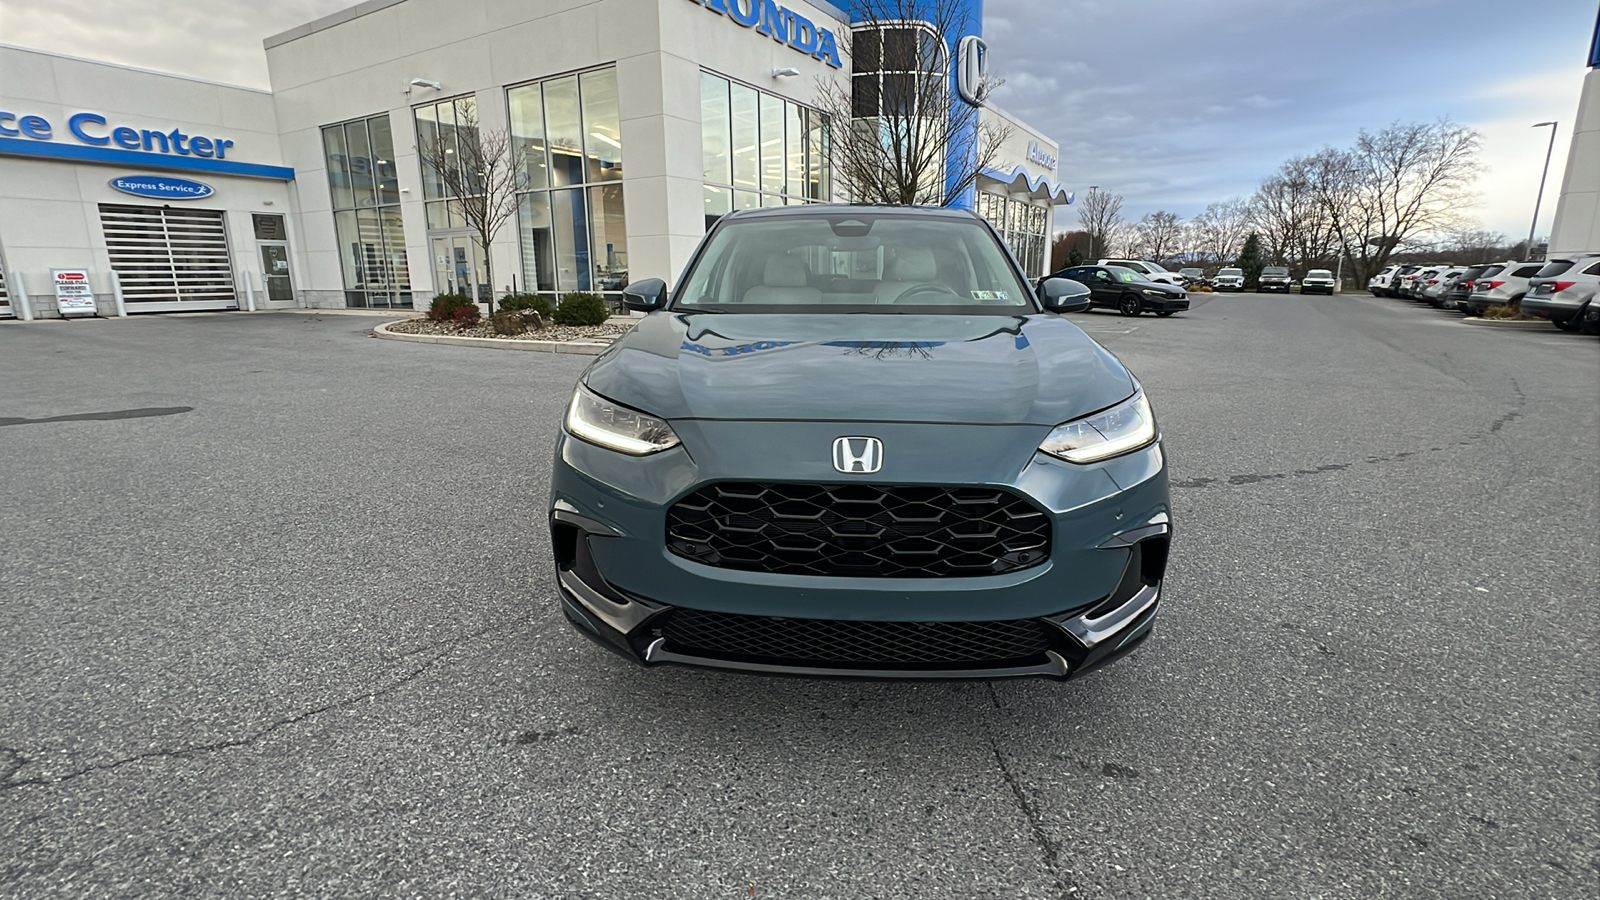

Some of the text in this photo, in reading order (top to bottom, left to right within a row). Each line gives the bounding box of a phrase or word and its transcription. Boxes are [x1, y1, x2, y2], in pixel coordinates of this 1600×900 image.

[690, 0, 843, 70] ONDA
[68, 112, 234, 159] Center
[117, 179, 194, 193] Express Service
